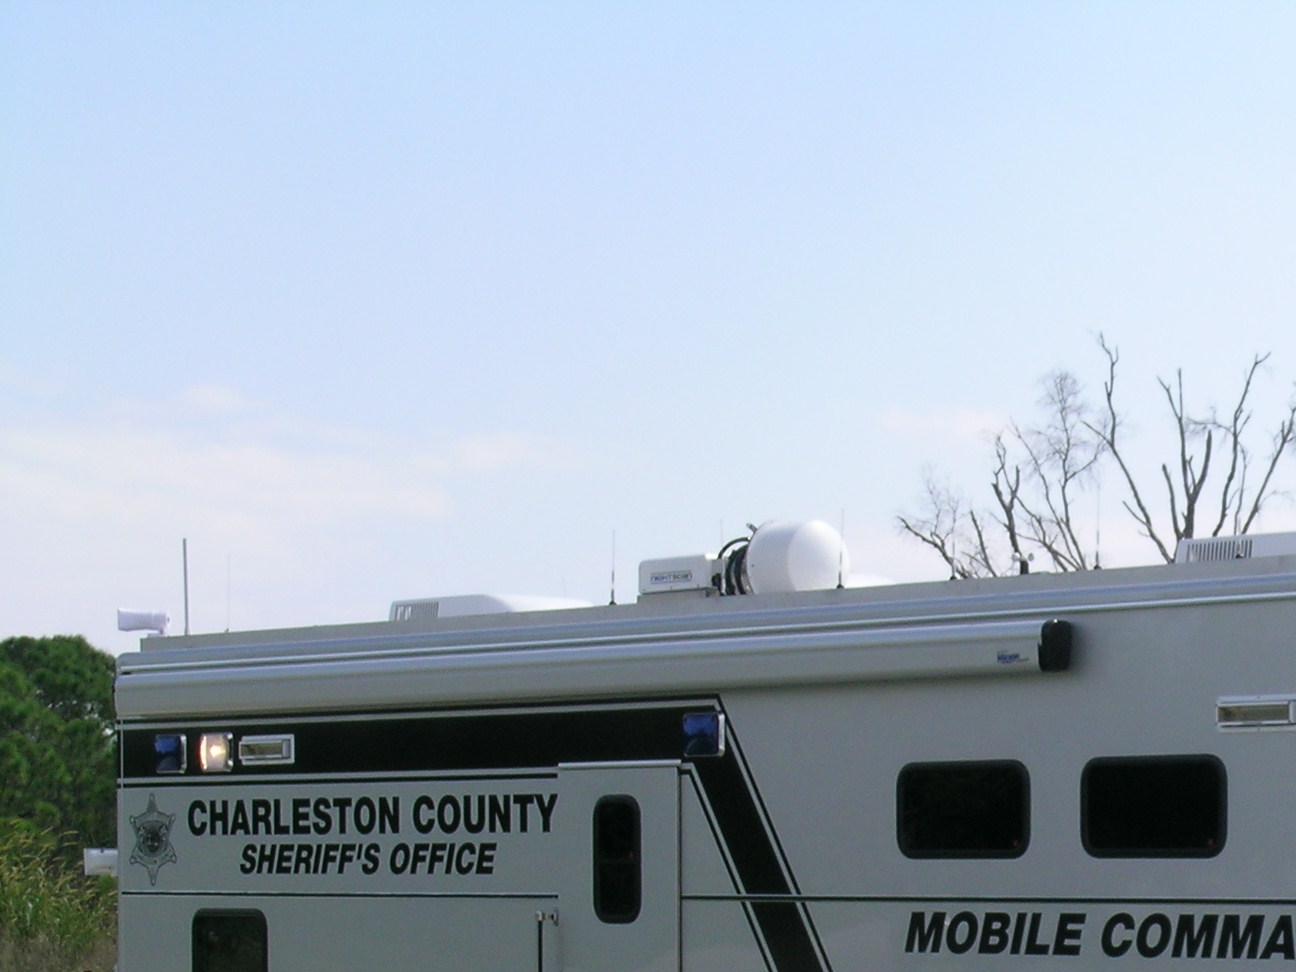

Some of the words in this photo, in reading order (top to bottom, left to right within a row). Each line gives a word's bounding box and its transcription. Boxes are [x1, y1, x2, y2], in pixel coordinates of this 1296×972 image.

[187, 796, 400, 836] CHARLESTON
[412, 793, 559, 835] COUNTY
[239, 843, 381, 875] SHERIFF'S
[389, 842, 498, 875] OFFICE
[904, 911, 1087, 955] MOBILE
